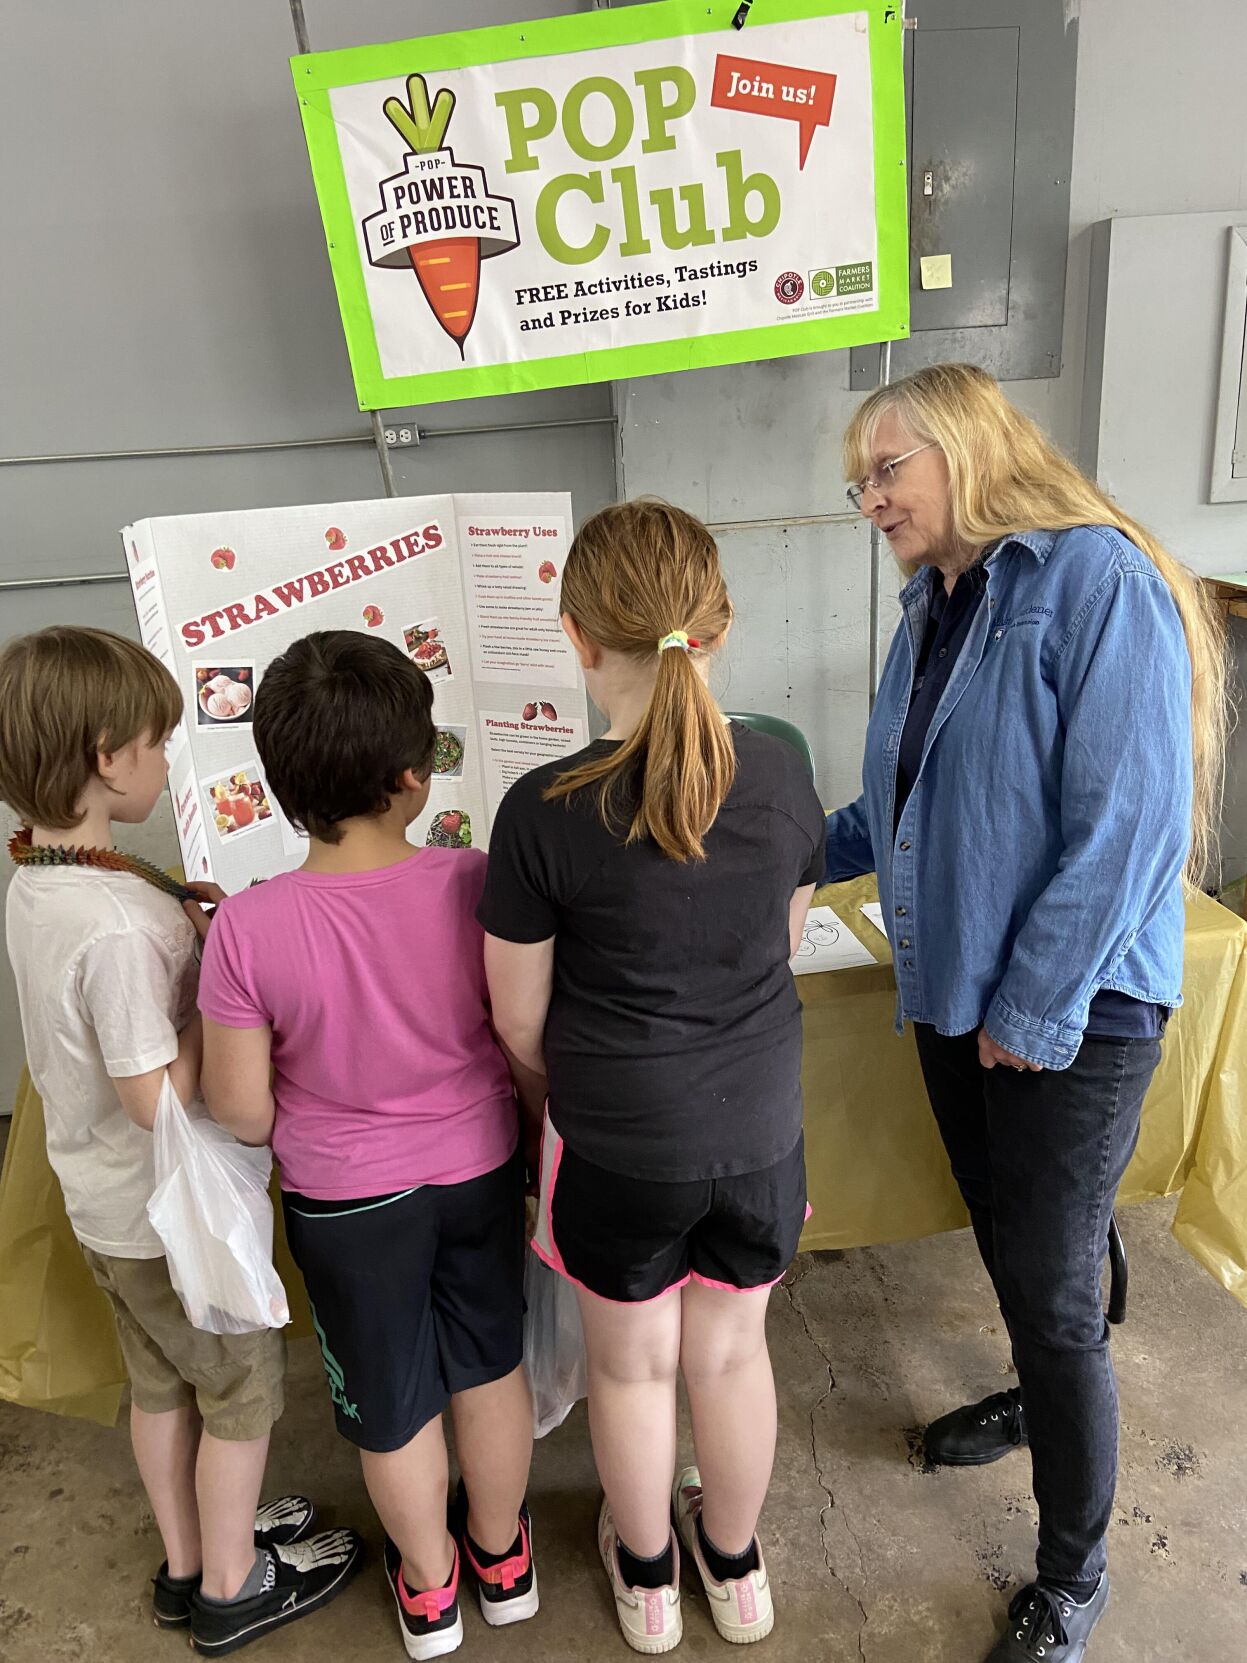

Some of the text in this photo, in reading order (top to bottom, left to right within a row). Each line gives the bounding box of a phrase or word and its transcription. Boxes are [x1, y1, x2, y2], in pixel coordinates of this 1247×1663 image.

[727, 71, 816, 105] Join us!
[494, 66, 696, 174] POP
[392, 176, 477, 210] POWER
[535, 149, 781, 265] Club
[380, 204, 502, 242] OF PRODUCE
[515, 260, 758, 306] FREE Activities, Tastings
[776, 272, 802, 288] CHIPOTLE
[838, 266, 870, 277] FARMERS
[839, 274, 870, 284] MARKET
[840, 283, 870, 292] COALITION
[520, 290, 707, 332] and Prizes for Kids!
[468, 526, 558, 538] Strawberry Uses
[181, 524, 443, 648] STRAWBERRIES
[486, 719, 574, 734] Planting Strawberries
